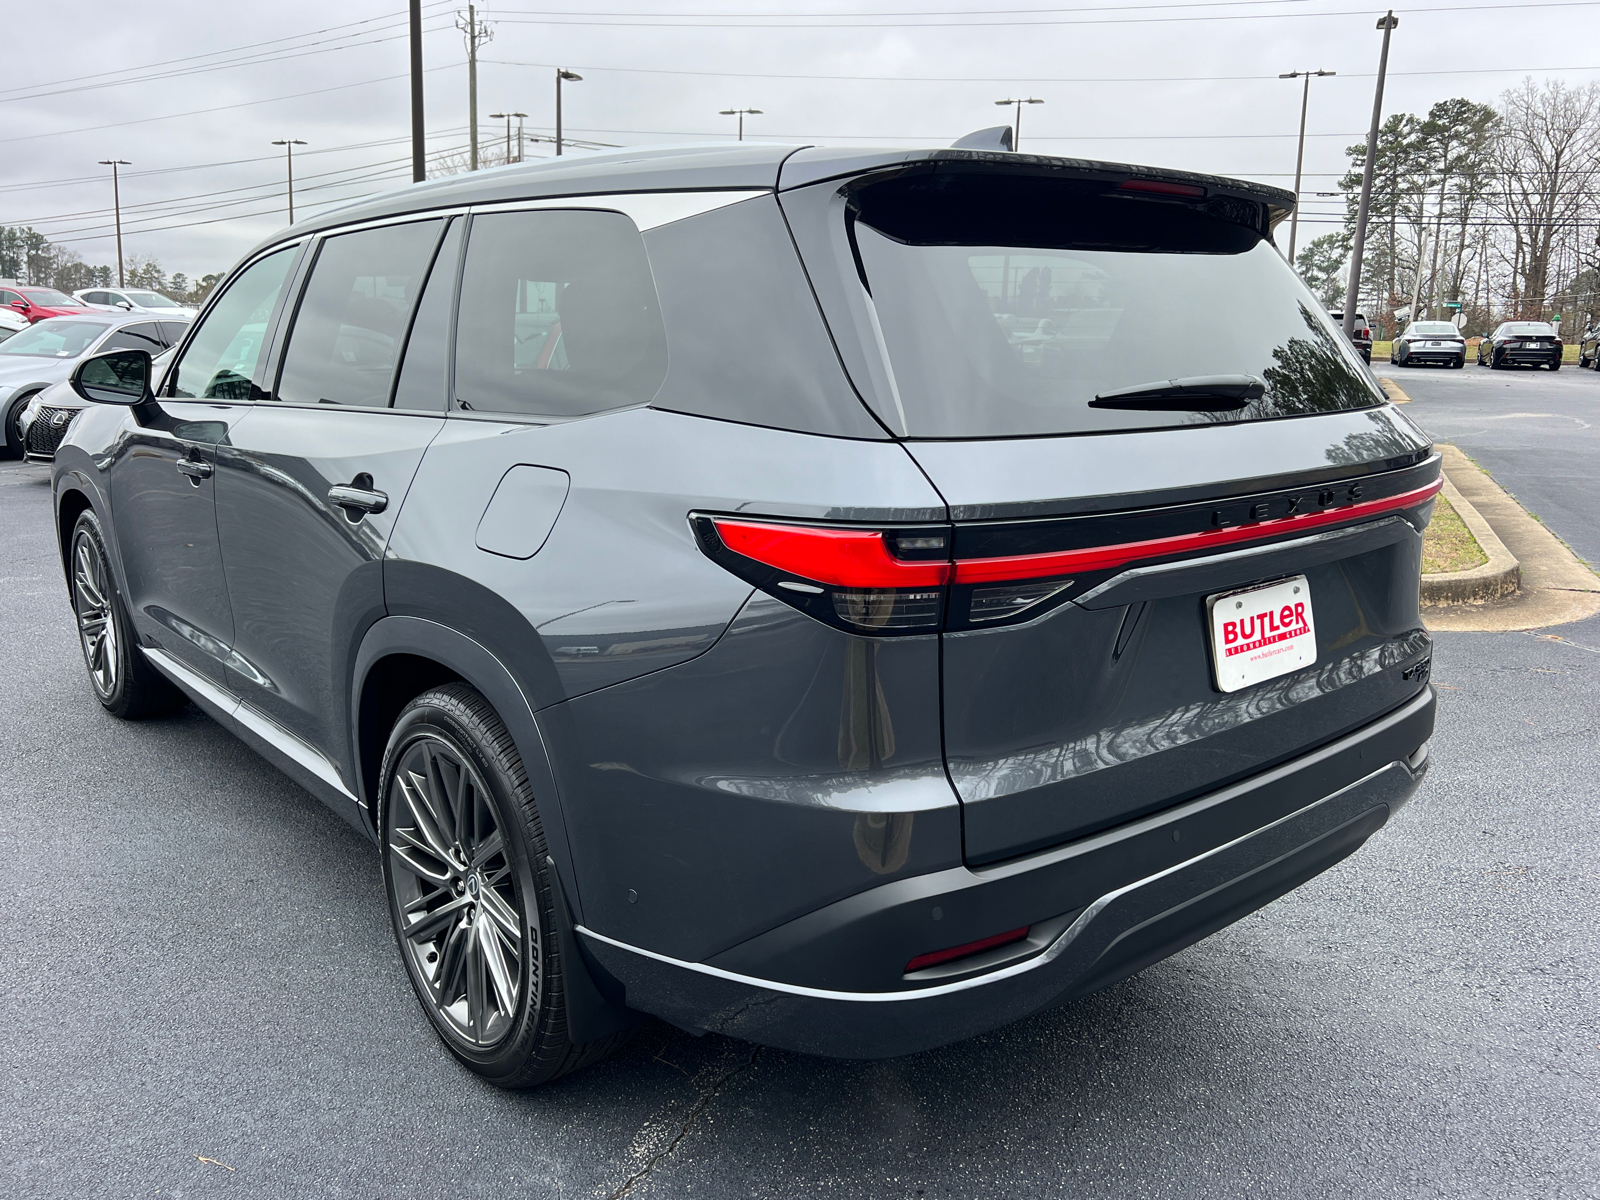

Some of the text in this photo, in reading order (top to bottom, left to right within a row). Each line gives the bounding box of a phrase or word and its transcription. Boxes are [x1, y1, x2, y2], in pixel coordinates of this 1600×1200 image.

[1211, 484, 1363, 527] LEXUS
[1225, 626, 1310, 657] AUTOMOTIVE GROUP
[1250, 644, 1294, 662] www.butlercars.com
[443, 715, 477, 749] CROSSCONTACT
[515, 926, 540, 1056] CONTINENTAL
